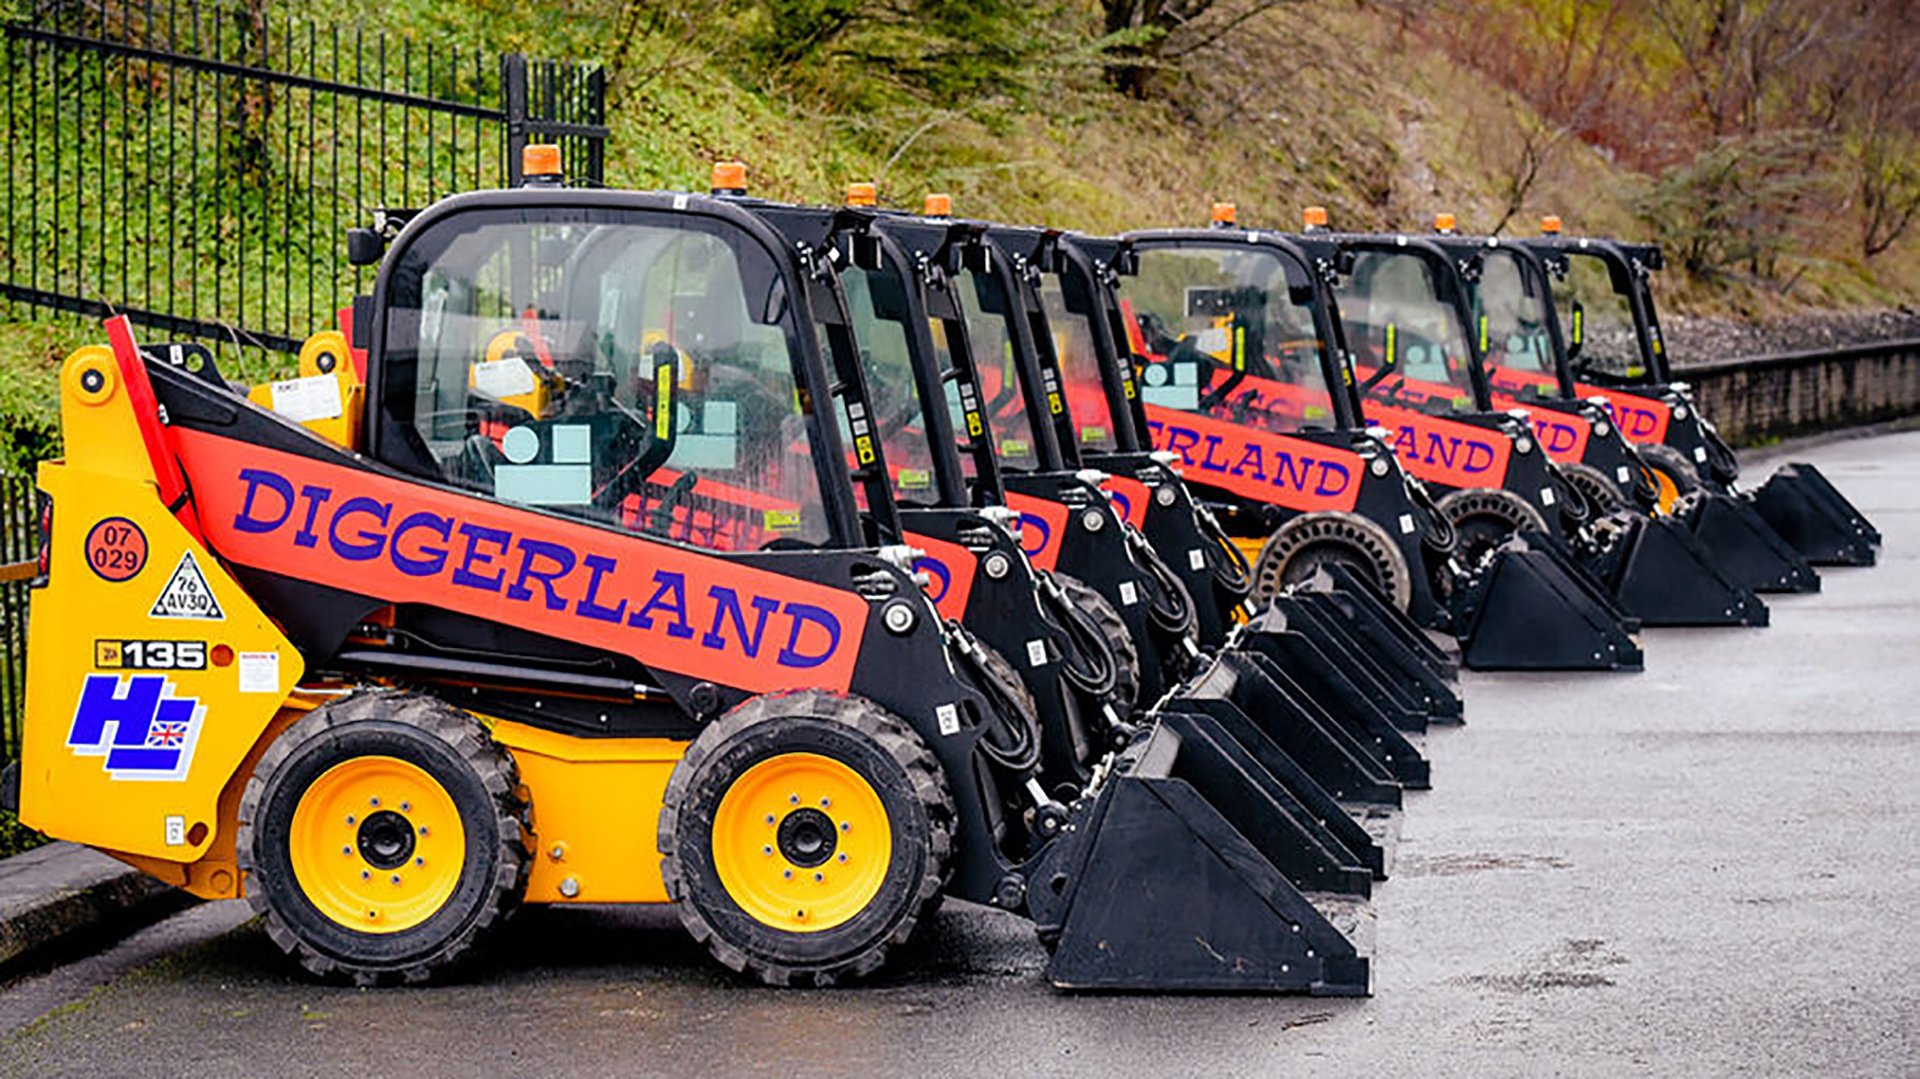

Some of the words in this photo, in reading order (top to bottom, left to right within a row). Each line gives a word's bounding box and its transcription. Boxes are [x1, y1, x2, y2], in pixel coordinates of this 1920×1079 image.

[104, 526, 131, 546] 07
[94, 548, 137, 570] 029
[233, 468, 842, 669] DIGGERLAND
[178, 576, 198, 593] 76
[123, 641, 204, 669] 135
